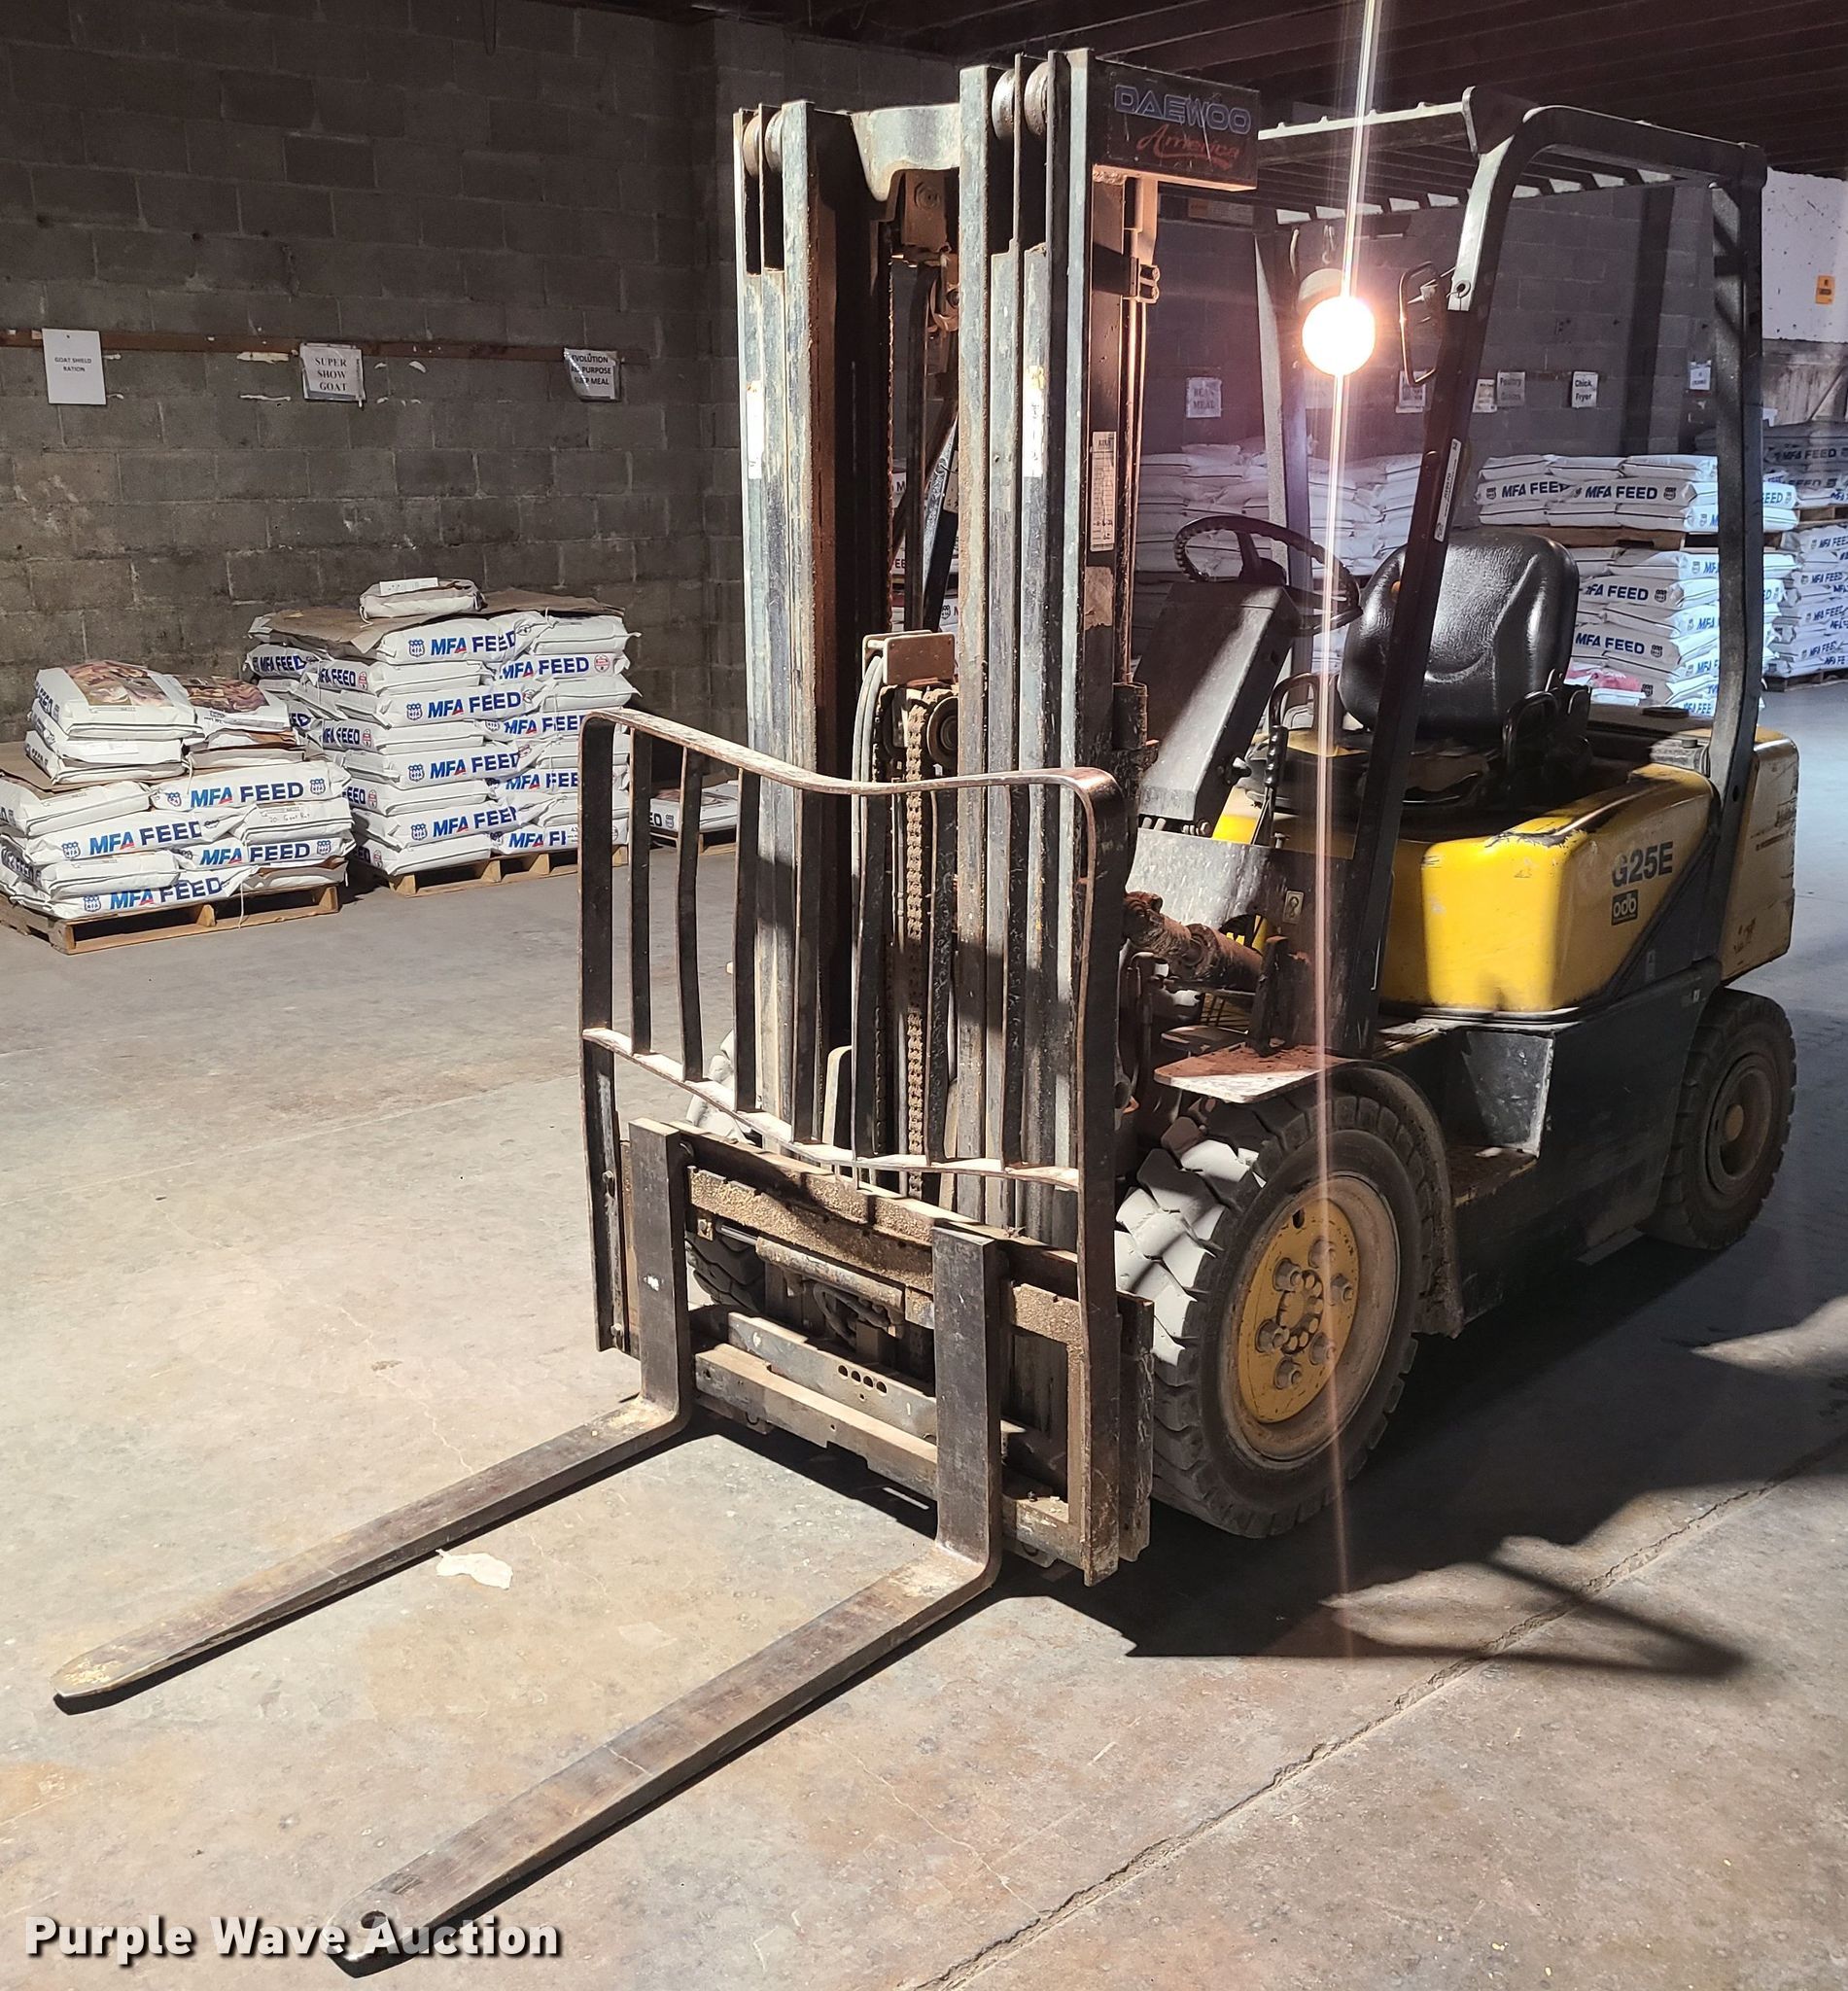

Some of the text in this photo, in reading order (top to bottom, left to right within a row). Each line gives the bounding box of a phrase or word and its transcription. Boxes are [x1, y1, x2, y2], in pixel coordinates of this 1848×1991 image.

[1114, 84, 1252, 135] DAEWOO
[315, 358, 347, 367] SUPER
[317, 370, 346, 379] SHOW
[1575, 379, 1593, 388] Chick
[319, 382, 347, 391] GOAT
[1575, 393, 1592, 402] Fryer
[1804, 448, 1837, 460] FEED
[1501, 483, 1527, 499] MFA
[1585, 485, 1657, 500] MFA FEED
[1703, 562, 1719, 574] MF
[1607, 585, 1649, 601] FEED
[431, 637, 468, 655] MFA
[1575, 632, 1645, 654] MFA FEED
[275, 654, 307, 672] FEED
[539, 656, 590, 675] FEED
[331, 668, 357, 687] FEED
[428, 691, 521, 718] MFA FEED
[336, 727, 361, 745] FEED
[504, 719, 537, 735] MFA
[430, 758, 467, 780] MFA
[505, 772, 578, 790] MFA FEE
[190, 782, 304, 808] MFA FEED
[433, 816, 469, 837] MFA
[89, 830, 134, 856] MFA
[508, 832, 543, 848] MFA
[199, 843, 311, 865] MFA FEED
[1611, 841, 1673, 888] G25E
[110, 877, 223, 910] MFA FEED
